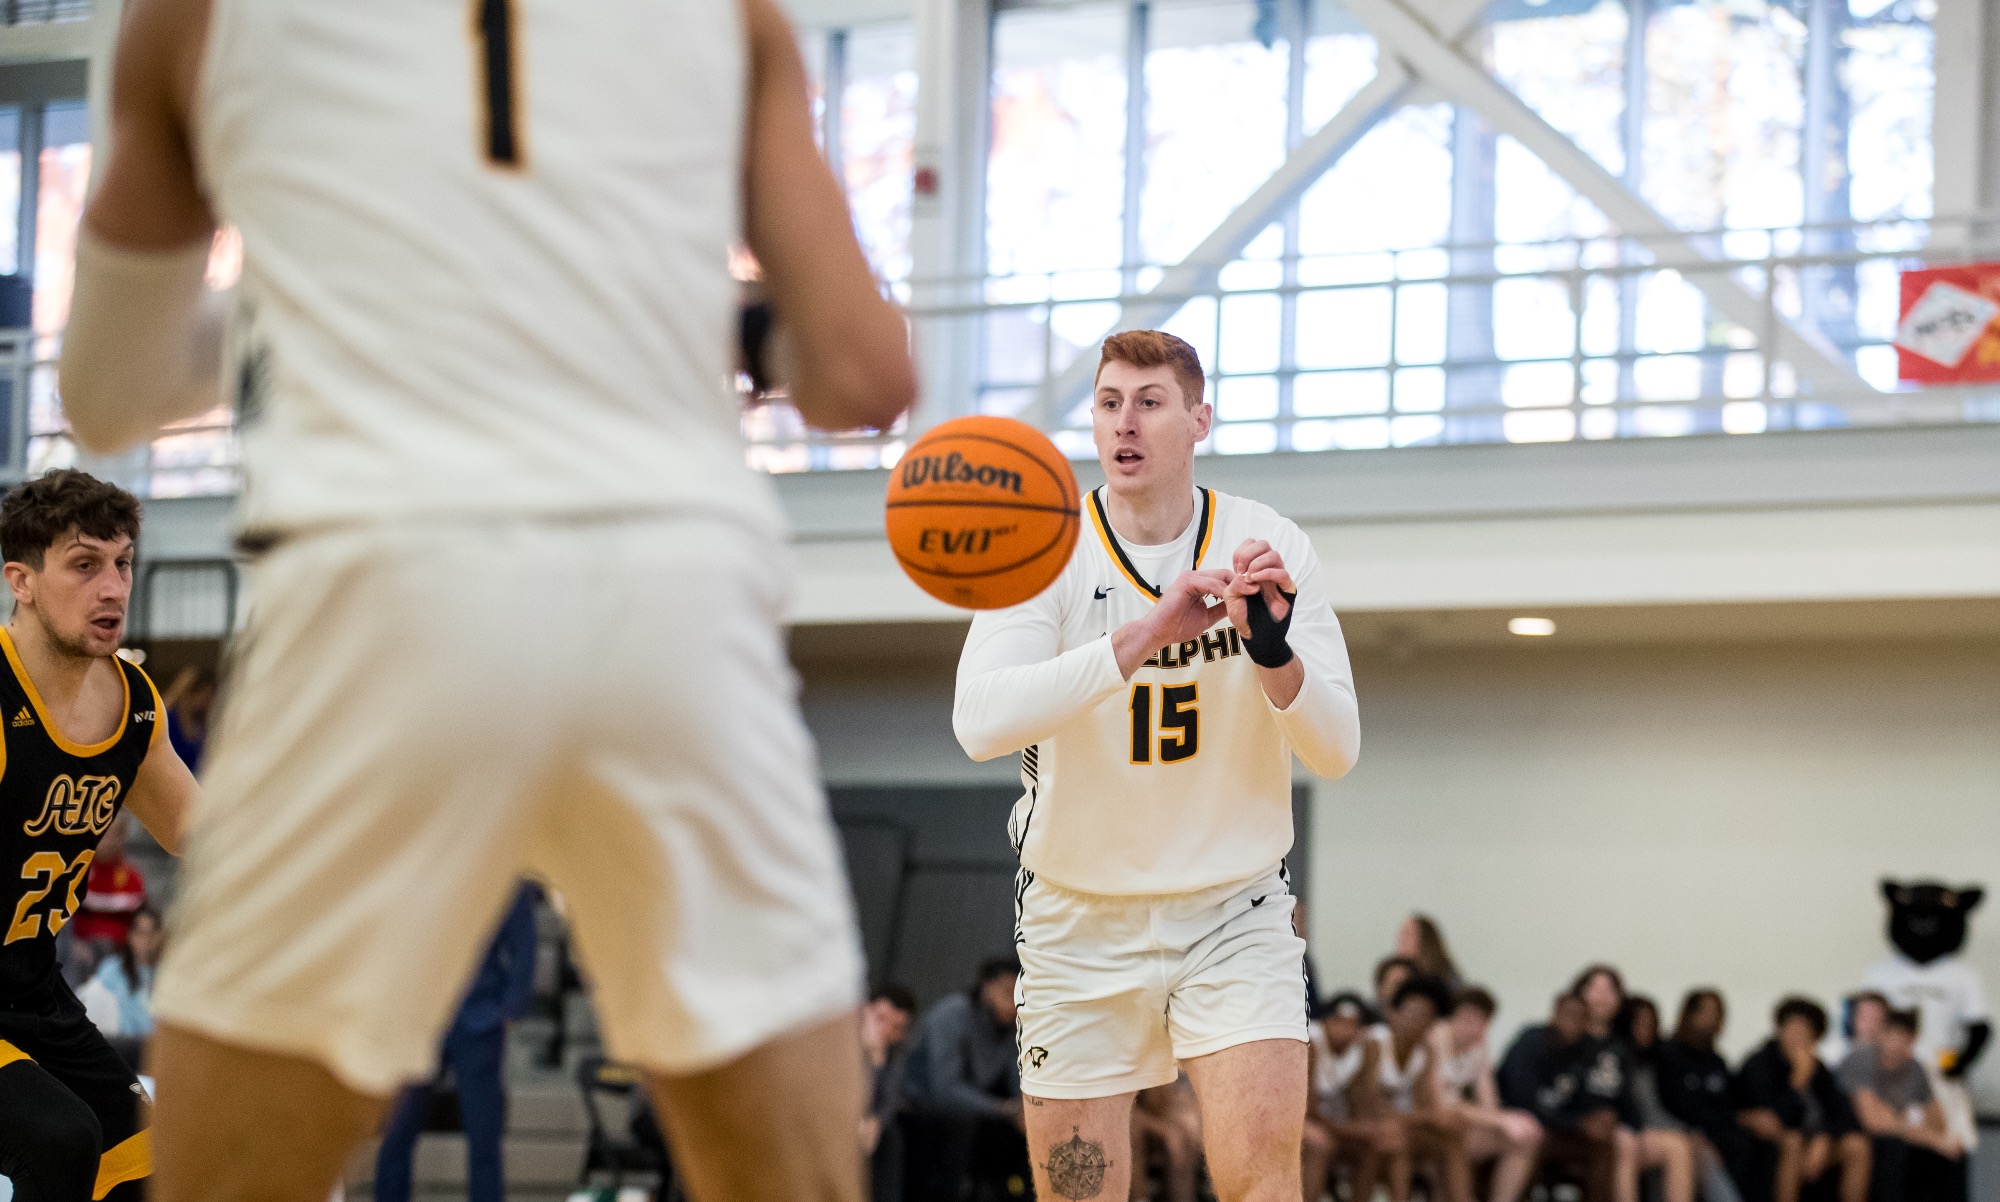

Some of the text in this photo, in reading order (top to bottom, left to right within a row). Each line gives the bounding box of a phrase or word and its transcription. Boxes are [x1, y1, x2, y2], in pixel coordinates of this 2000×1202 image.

[468, 0, 531, 172] 1
[902, 451, 1024, 495] Wilson
[1128, 681, 1200, 765] 15
[23, 774, 121, 836] AIC
